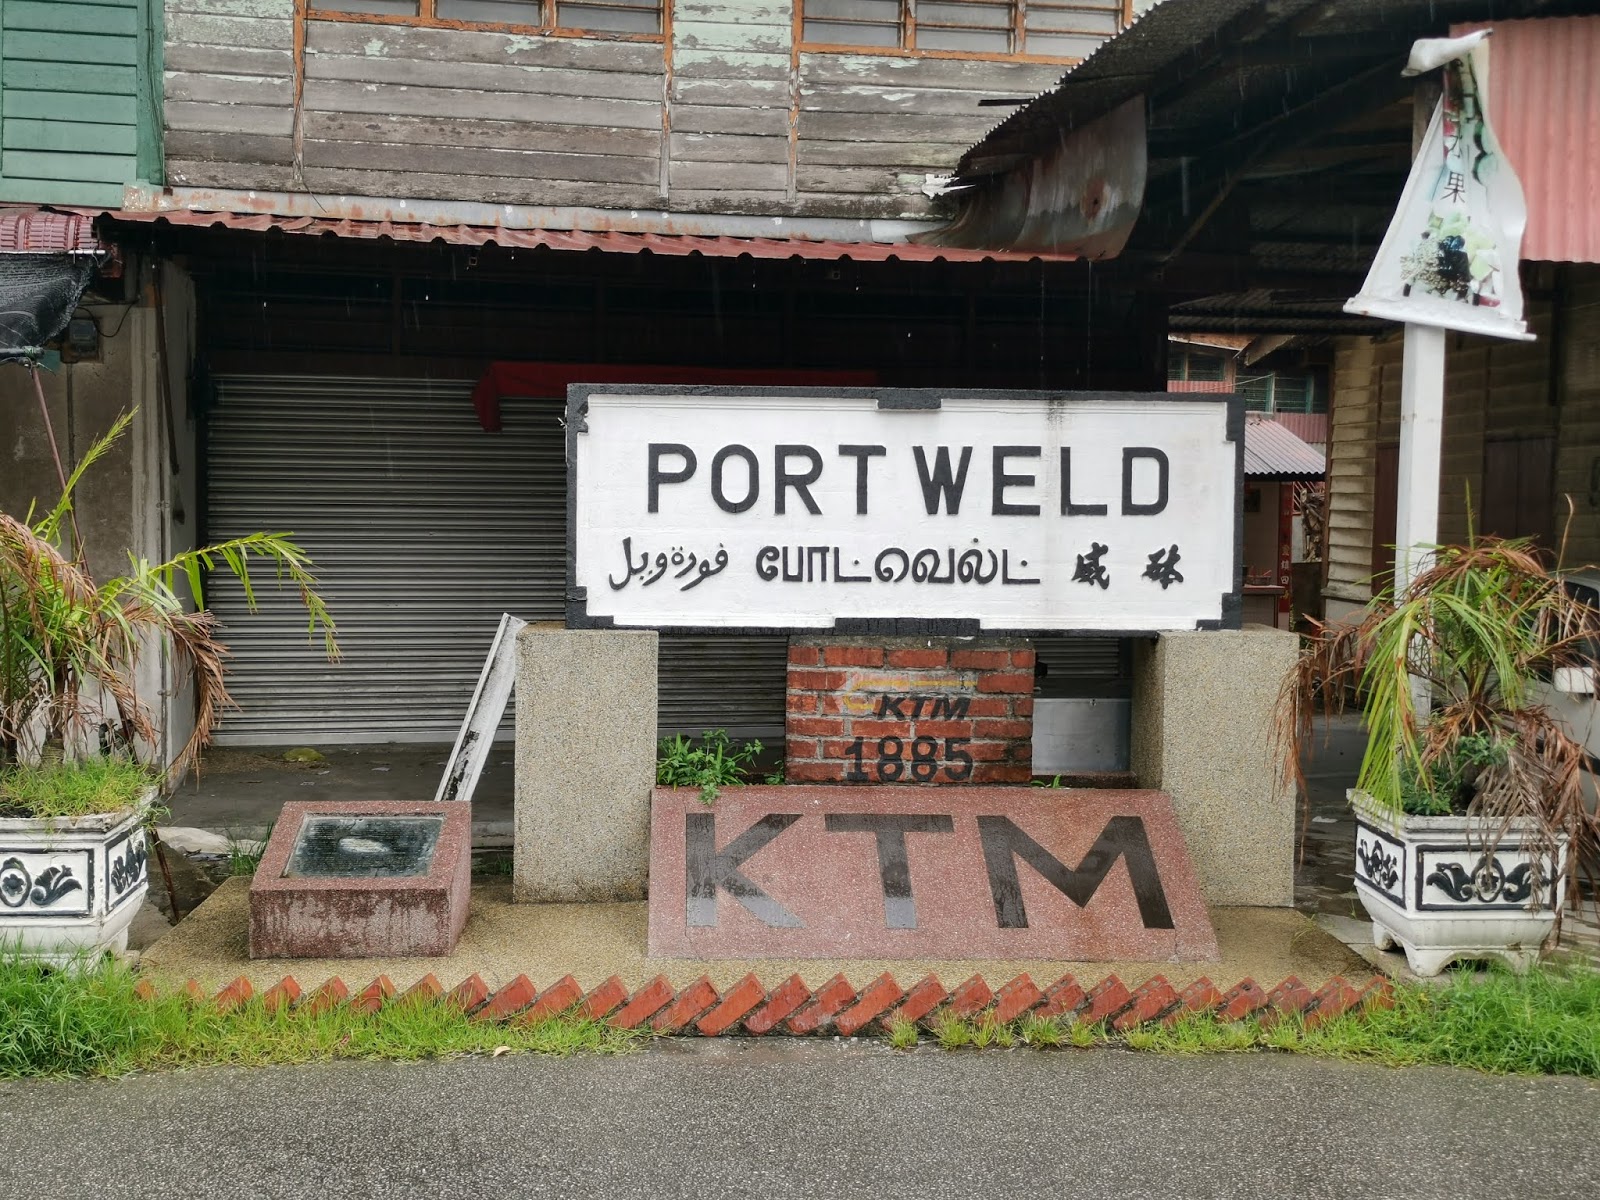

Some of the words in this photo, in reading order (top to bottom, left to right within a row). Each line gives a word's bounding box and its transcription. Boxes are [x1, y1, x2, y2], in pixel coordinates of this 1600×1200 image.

[647, 443, 887, 515] PORT
[912, 445, 1170, 517] WELD
[875, 694, 971, 721] KTM
[844, 735, 974, 782] 1885
[685, 812, 1176, 930] KTM
